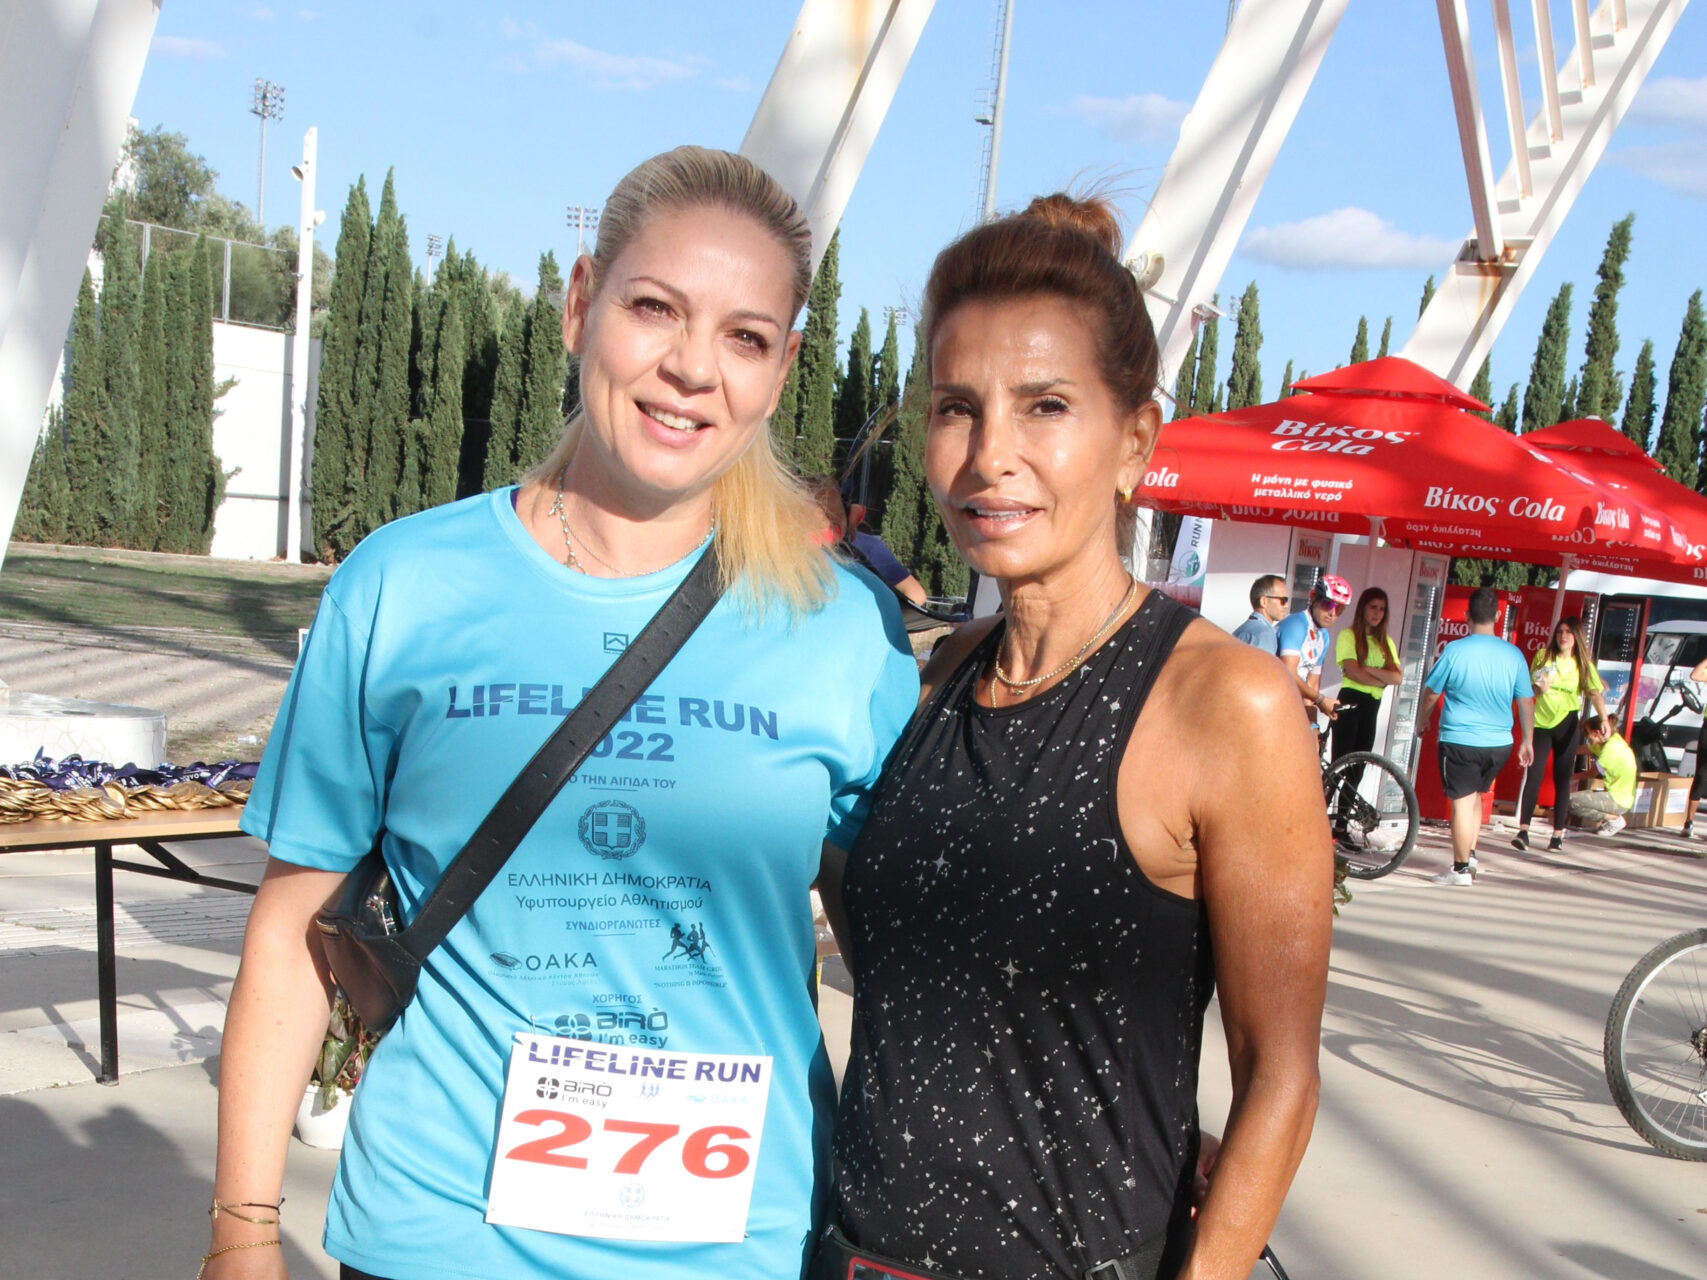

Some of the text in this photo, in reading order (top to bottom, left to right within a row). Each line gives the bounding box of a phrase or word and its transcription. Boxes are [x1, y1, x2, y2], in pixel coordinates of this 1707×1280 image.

[1271, 420, 1412, 444] Βίκος
[1271, 439, 1375, 455] Cola
[1144, 467, 1179, 487] ola
[1263, 474, 1291, 487] μόνη
[1294, 478, 1308, 488] με
[1311, 478, 1353, 490] φυσικό
[1253, 487, 1342, 502] μεταλλικό νερό
[1424, 486, 1566, 522] Βίκος Cola
[1437, 617, 1471, 637] Βίκο
[1524, 621, 1551, 637] Βίκ
[1527, 637, 1546, 651] Co
[446, 683, 779, 740] LIFELE RUN
[590, 730, 675, 762] 022
[581, 774, 607, 785] ΤΗΝ
[610, 776, 650, 788] ΑΙΓΙΔΑ
[653, 778, 676, 789] ΤΟΥ
[508, 872, 712, 893] ΕΛΛΗΝΙΚΗ ΔΗΜΟΚΡΑΤΙΑ
[515, 893, 703, 912] Υφυπουργείο Αθλητισμού
[566, 918, 662, 931] ΣΥΝΔΙΟΡΓΑΝΩΤΕΣ
[592, 993, 643, 1005] ΧΟΡΗΓΟΣ
[629, 1034, 668, 1049] easy
[528, 1042, 762, 1083] LIFELINE RUN
[505, 1109, 752, 1180] 276
